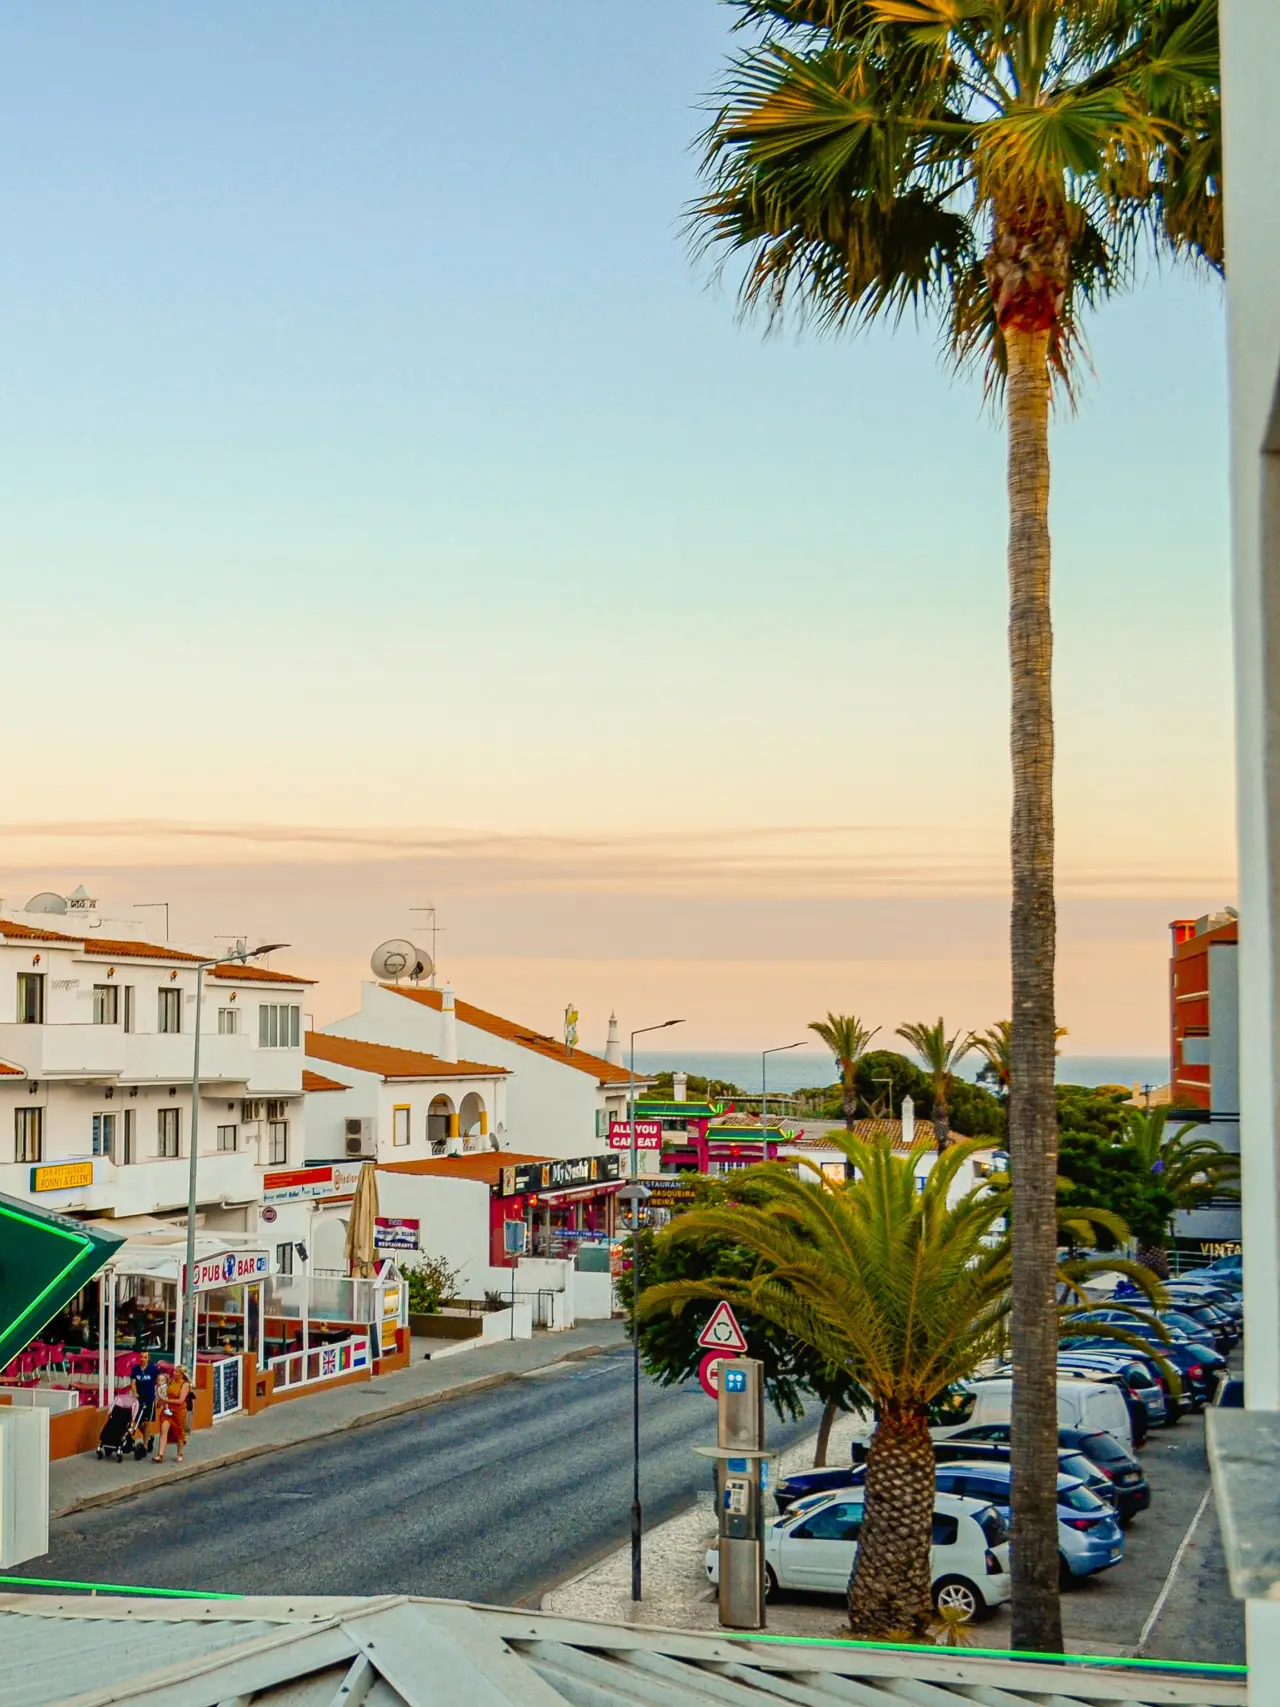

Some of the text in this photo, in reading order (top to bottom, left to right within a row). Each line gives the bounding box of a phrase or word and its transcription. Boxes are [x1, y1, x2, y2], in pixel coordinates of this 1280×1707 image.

[612, 1124, 658, 1134] ALL YOU
[637, 1138, 658, 1147] EAT
[202, 1264, 220, 1283] PUB
[238, 1257, 255, 1276] BAR
